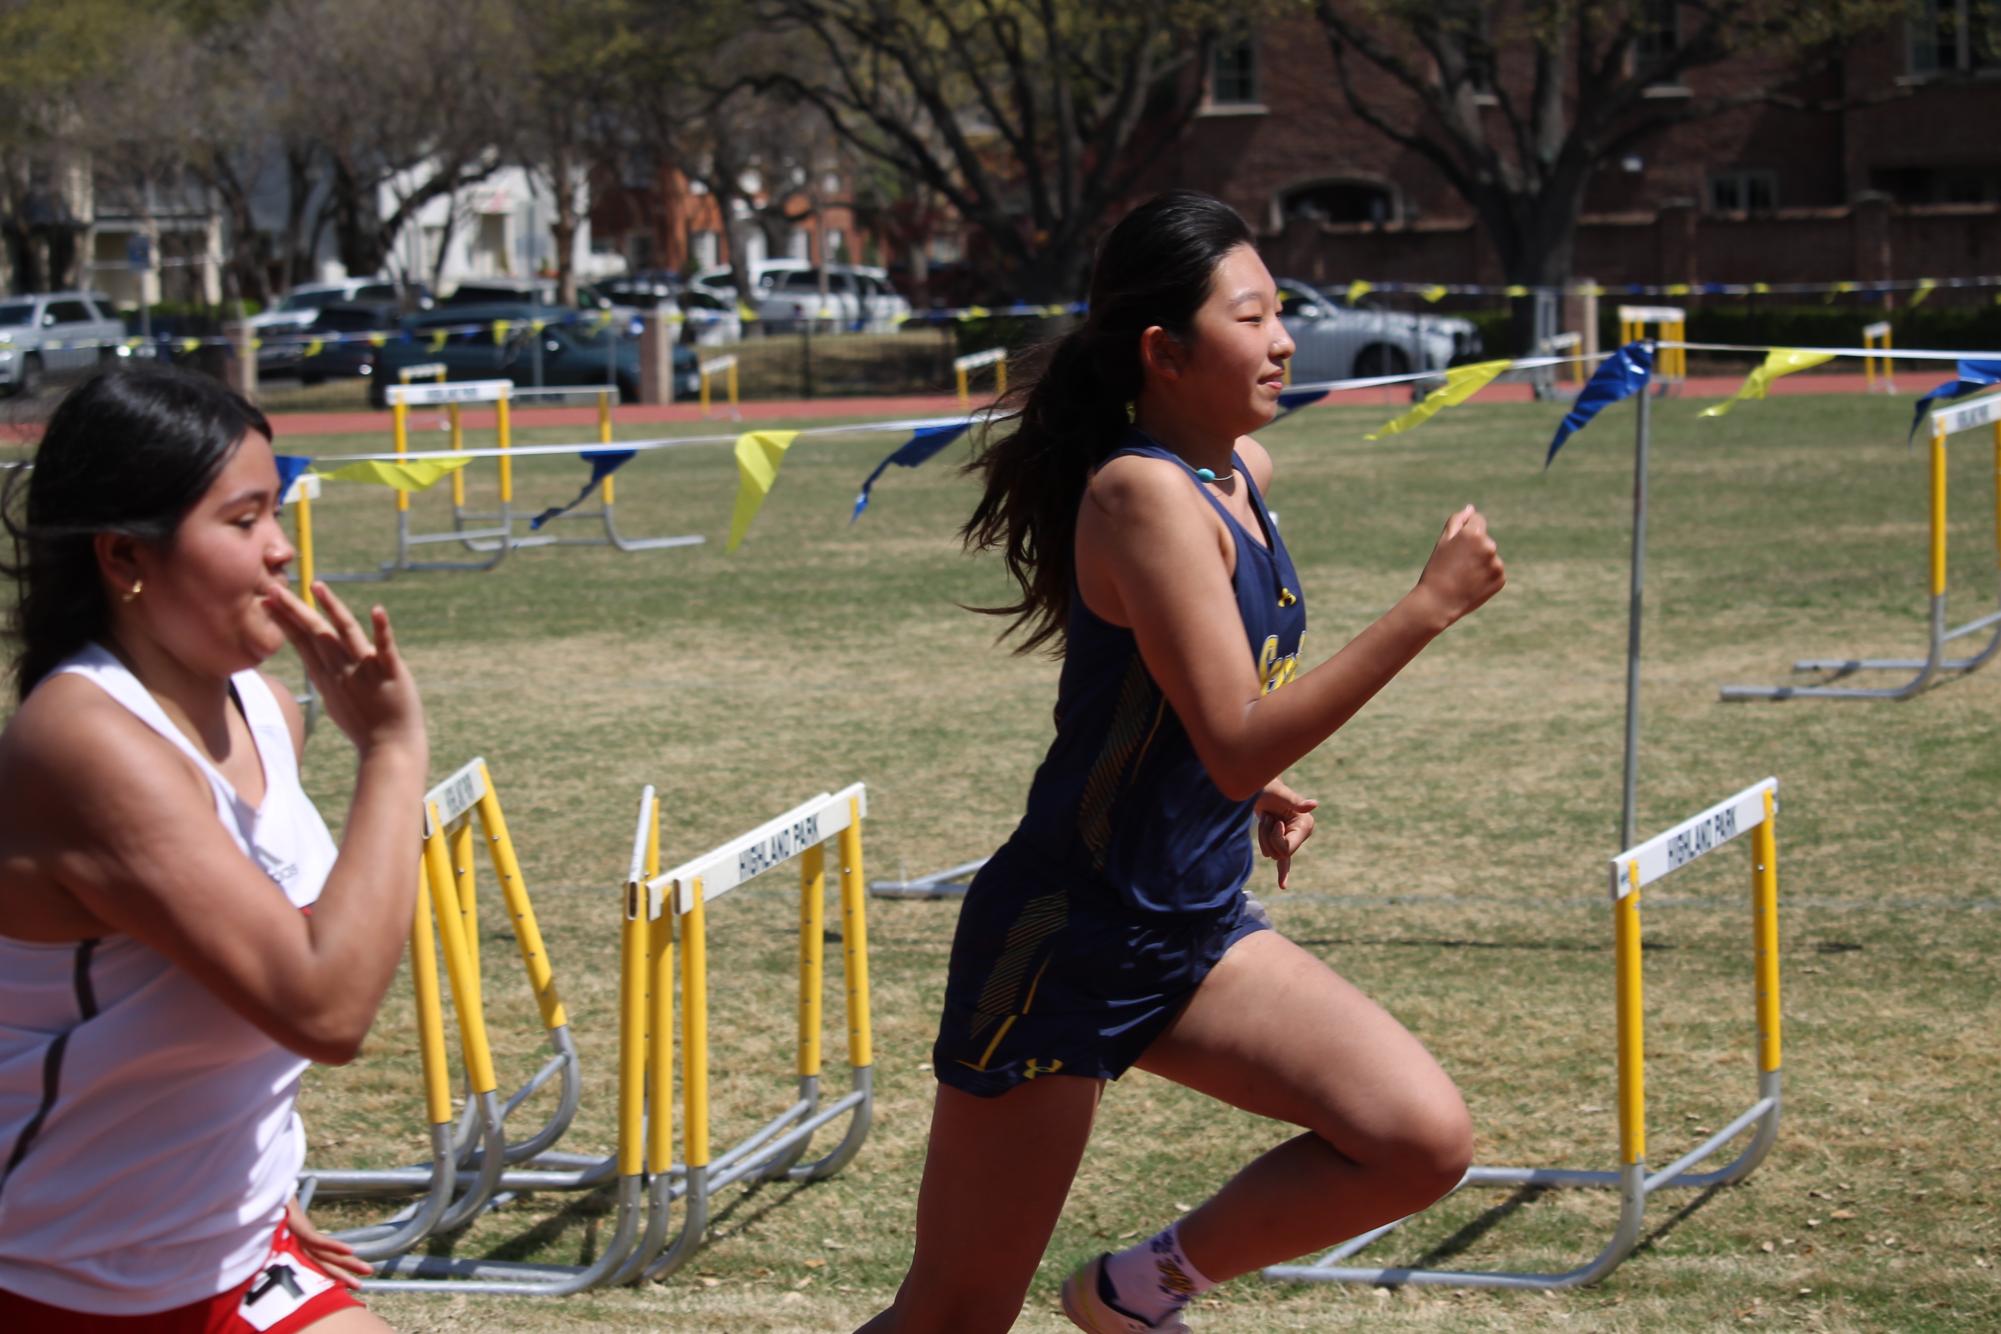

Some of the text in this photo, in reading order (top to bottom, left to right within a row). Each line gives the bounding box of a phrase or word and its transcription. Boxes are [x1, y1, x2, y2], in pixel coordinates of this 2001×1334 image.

[739, 813, 819, 880] HIGHLAND PARK
[1668, 805, 1738, 870] HIGHLAND PARK
